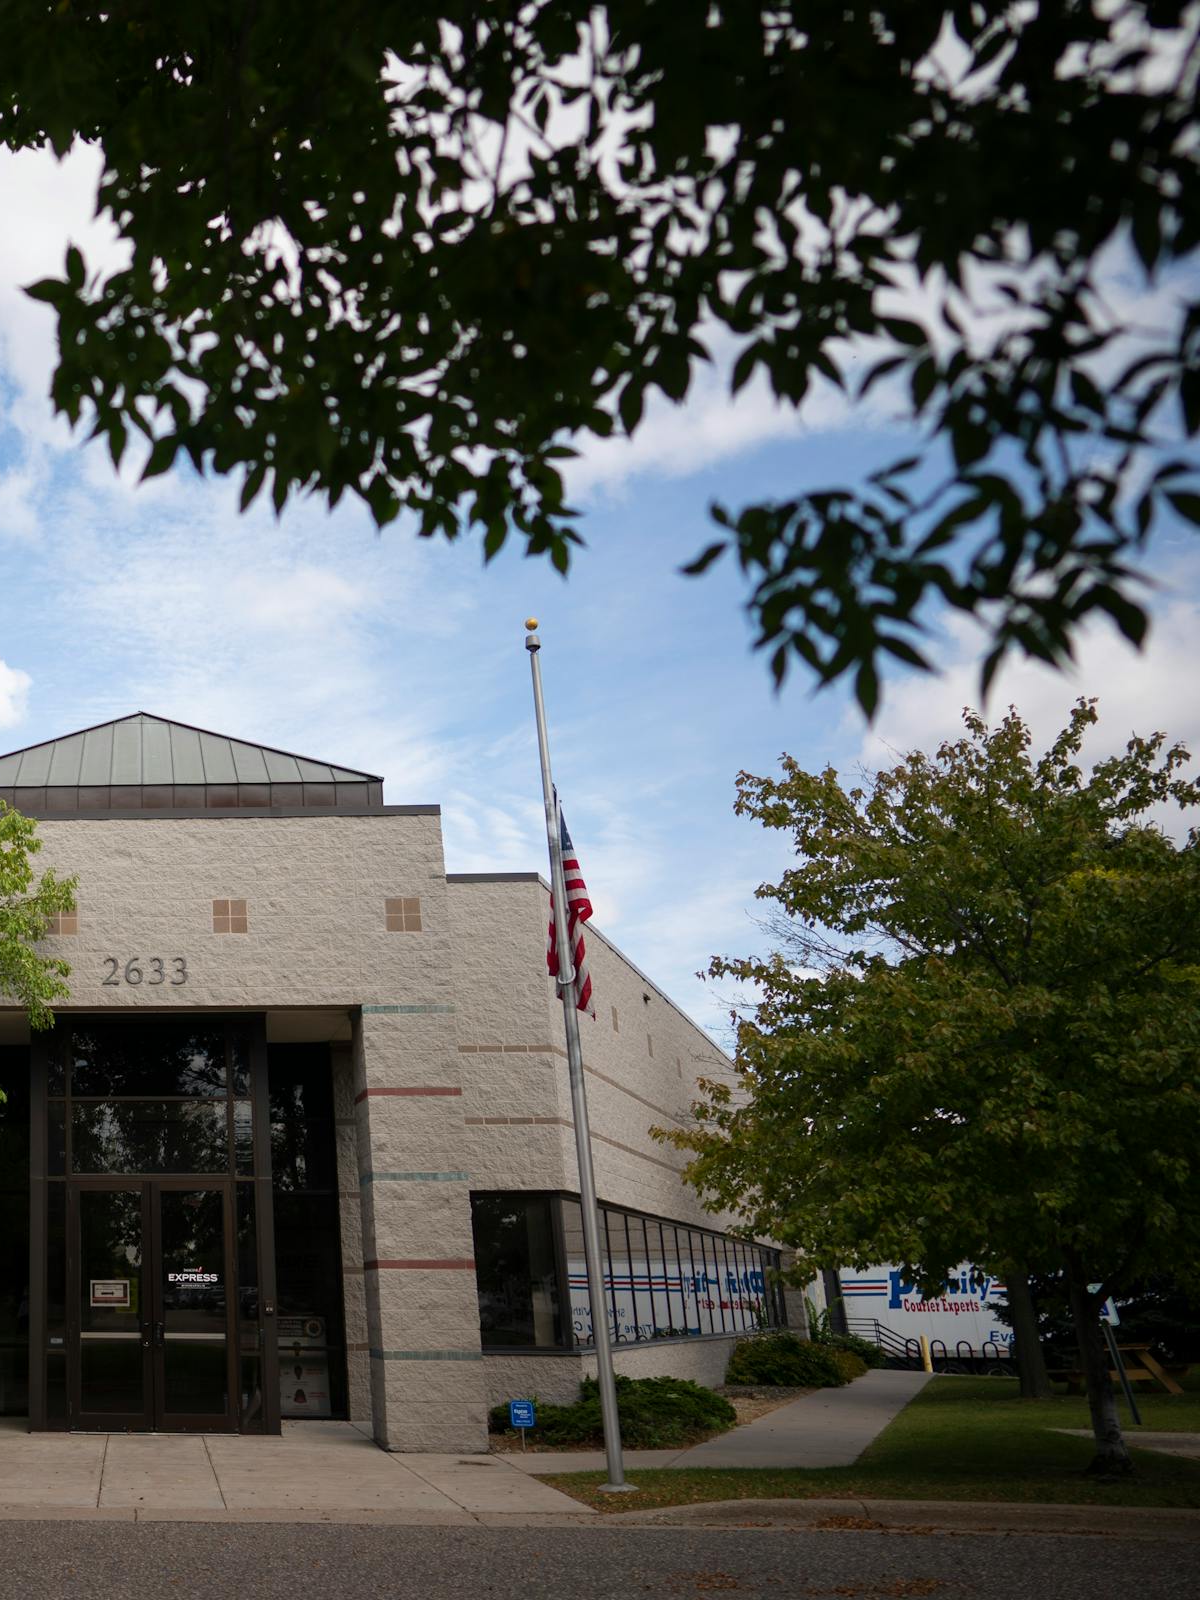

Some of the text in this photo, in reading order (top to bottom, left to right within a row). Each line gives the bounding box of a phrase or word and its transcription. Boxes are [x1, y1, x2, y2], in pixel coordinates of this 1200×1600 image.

[102, 957, 189, 986] 2633
[168, 1273, 218, 1282] EXPRESS
[904, 1298, 979, 1315] Courier Experts
